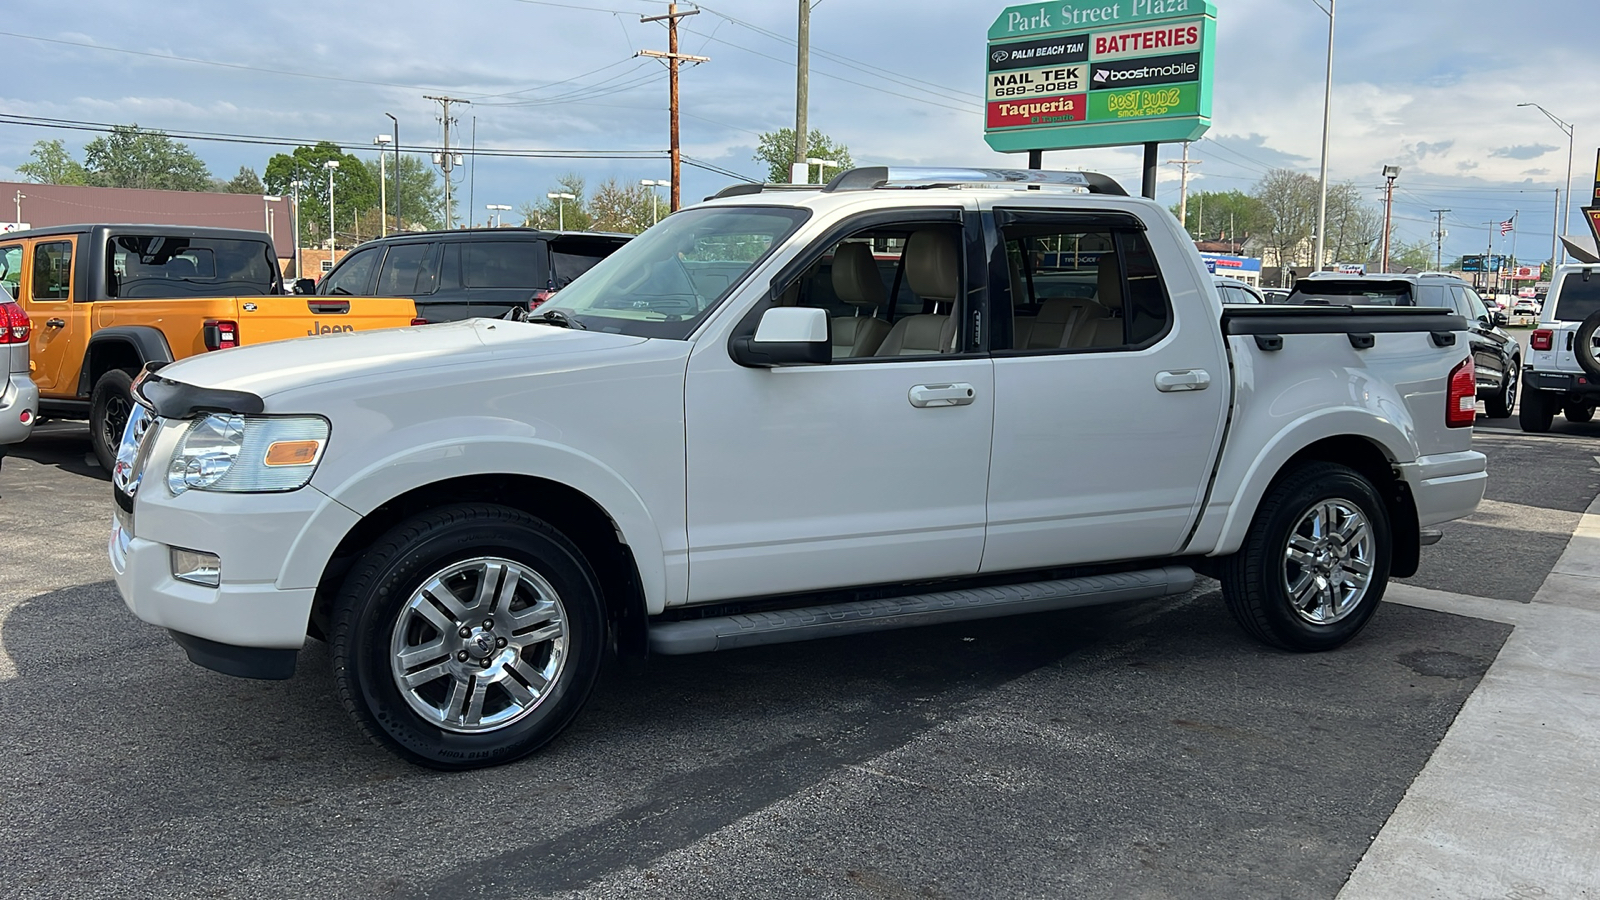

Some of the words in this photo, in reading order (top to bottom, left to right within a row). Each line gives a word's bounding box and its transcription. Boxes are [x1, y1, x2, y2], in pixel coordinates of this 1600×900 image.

[1007, 8, 1051, 32] Park
[1061, 3, 1120, 25] Street
[1131, 0, 1188, 16] Plaza
[1096, 26, 1198, 54] BATTERIES
[1011, 49, 1034, 59] PALM
[1036, 46, 1064, 56] BEACH
[1066, 43, 1084, 53] TAN
[994, 73, 1033, 86] NAIL
[1042, 68, 1079, 81] TEK
[995, 81, 1078, 96] 689-9088
[1117, 109, 1144, 118] SMOKE
[1146, 107, 1168, 116] SHOP
